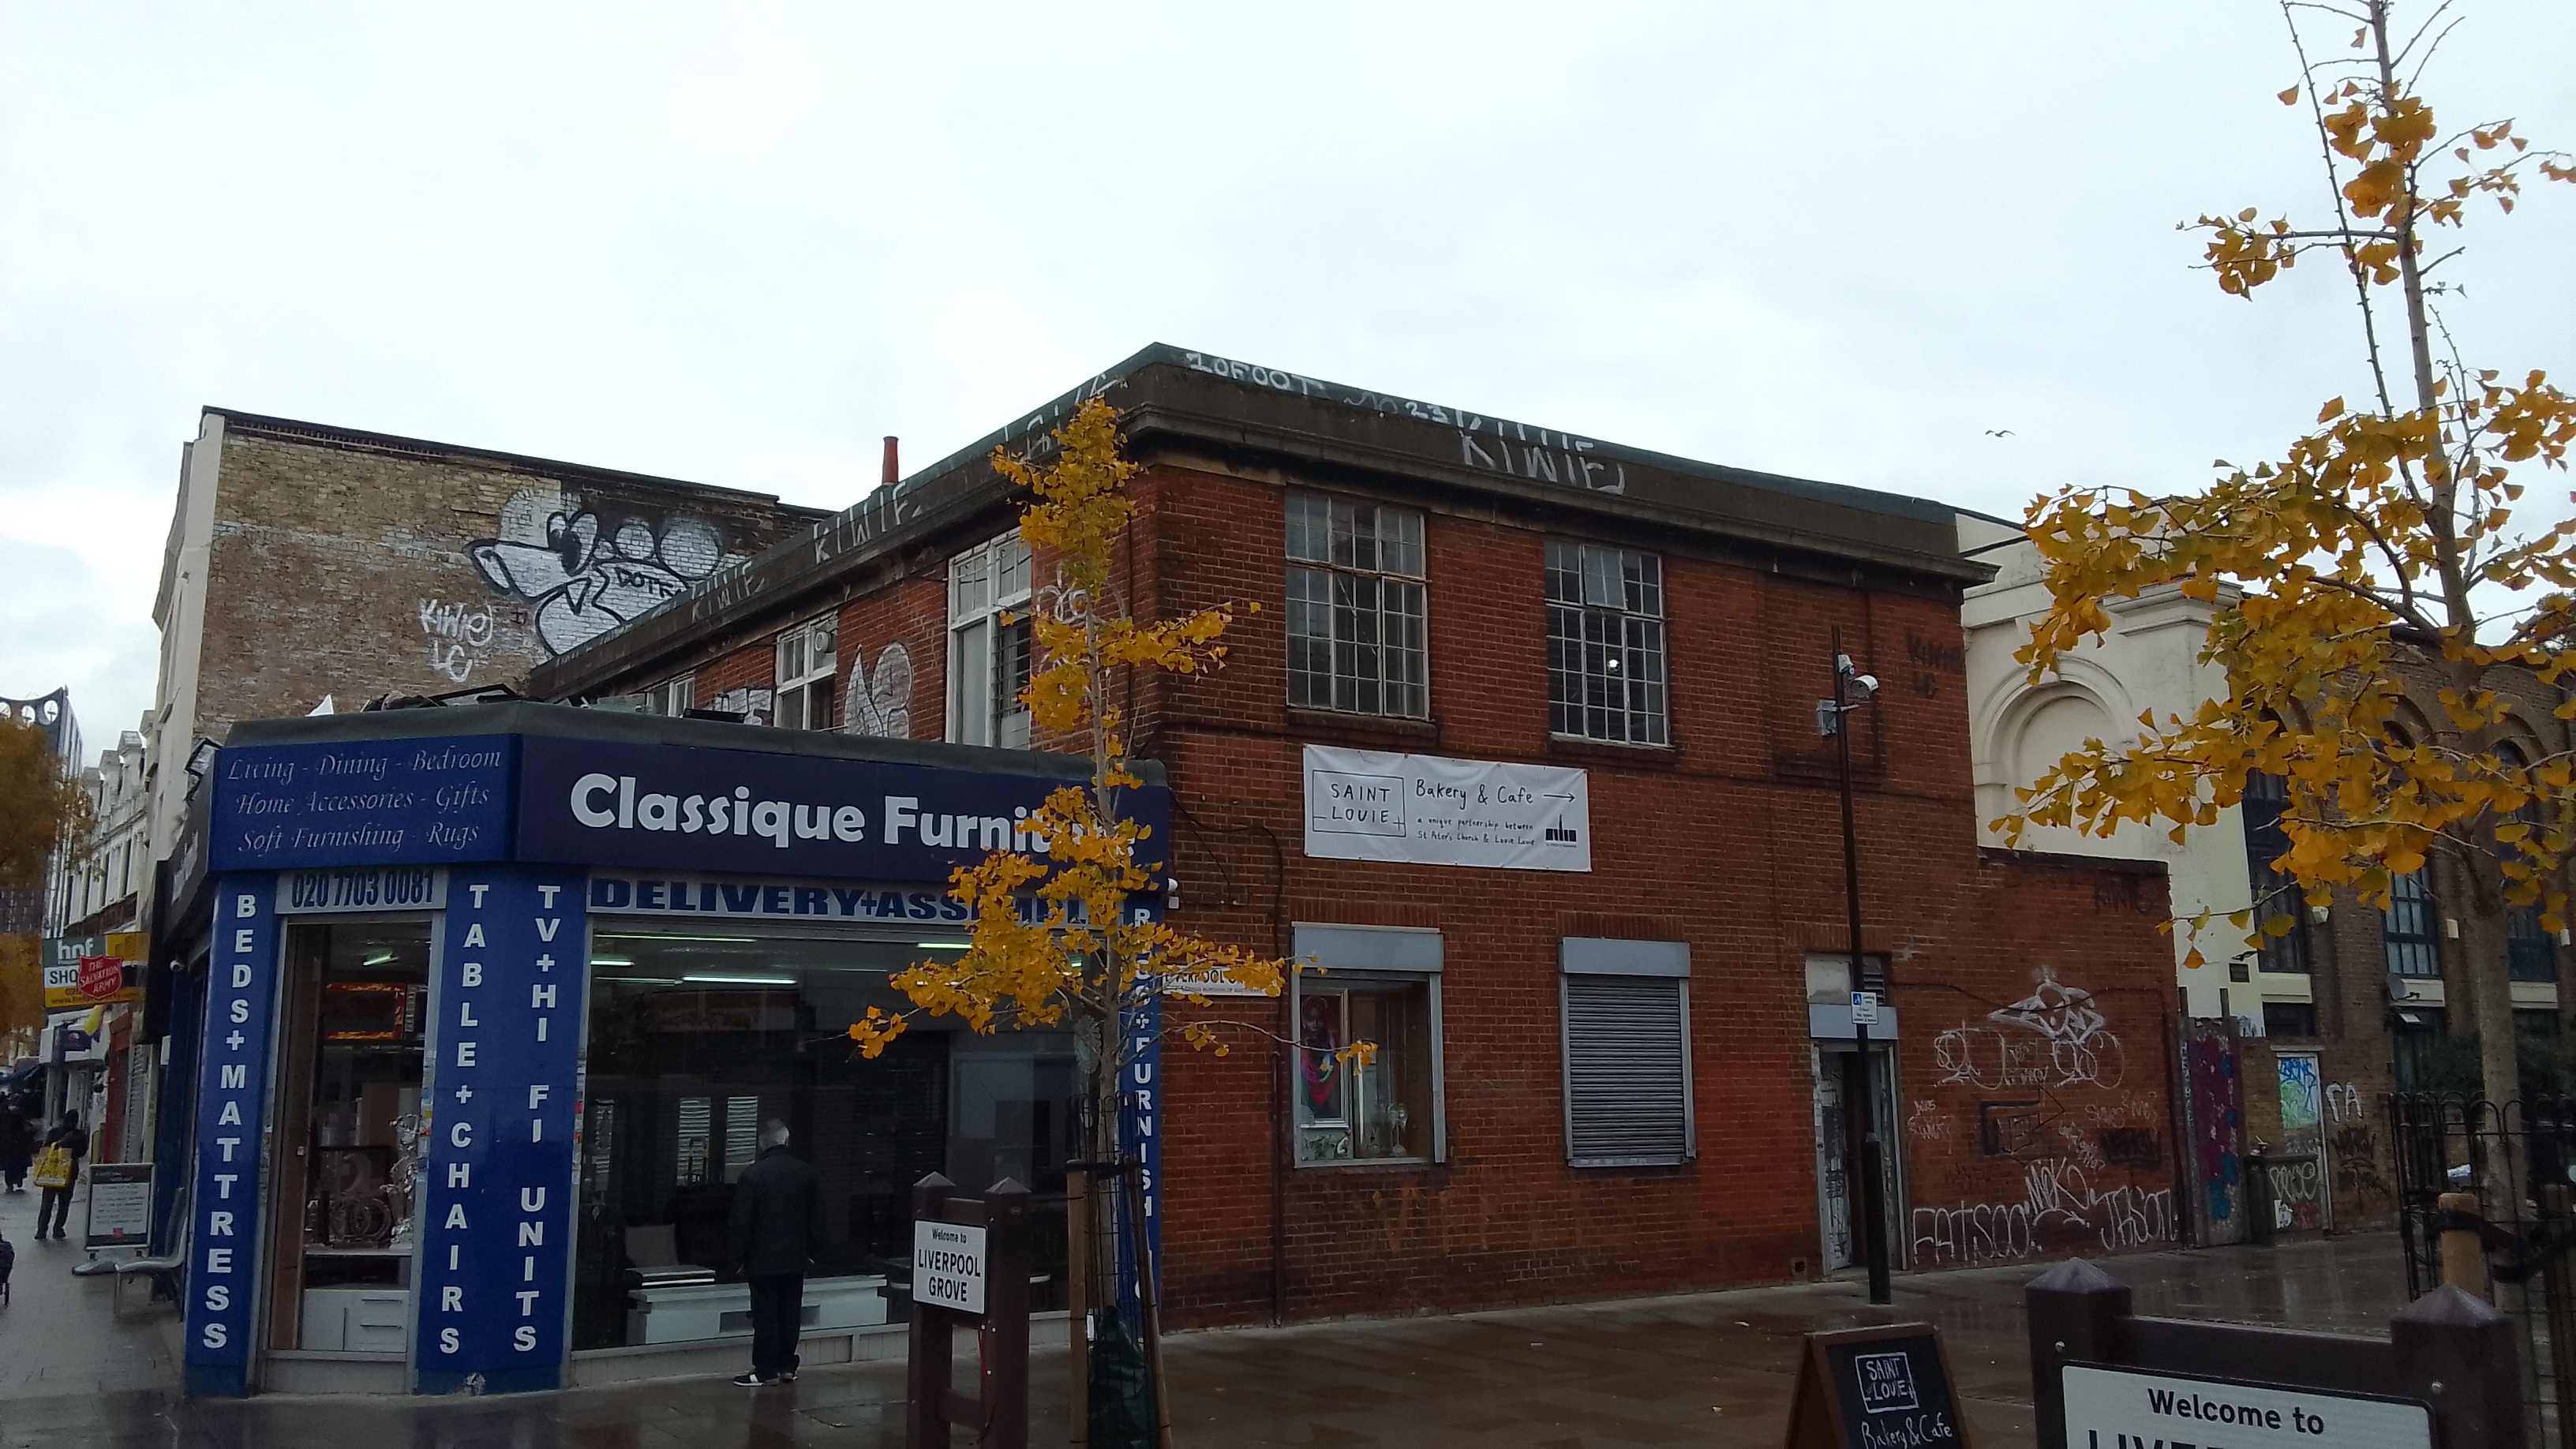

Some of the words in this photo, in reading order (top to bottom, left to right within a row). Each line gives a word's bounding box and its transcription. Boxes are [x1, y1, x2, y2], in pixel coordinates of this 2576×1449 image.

[227, 756, 295, 784] Living
[316, 753, 388, 781] Dining
[410, 745, 500, 772] Bedroom
[237, 792, 294, 816] Home
[297, 788, 414, 816] Accessories
[436, 781, 490, 814] Gifts
[1331, 783, 1391, 803] SAINT
[1416, 779, 1466, 810] Bakery
[1477, 784, 1488, 805] &
[1497, 785, 1533, 803] Cafe
[571, 773, 866, 849] Classique
[883, 795, 1136, 858] Furnit
[1331, 806, 1389, 823] LOUIE
[1428, 818, 1452, 829] unique
[1458, 818, 1500, 831] partnership
[1505, 822, 1533, 830] between
[238, 825, 283, 857] Soft
[291, 822, 404, 852] Furnishing
[426, 822, 480, 850] Rugs
[1417, 831, 1427, 840] St
[1456, 833, 1479, 842] Church
[1483, 833, 1489, 844] &
[291, 874, 330, 908] 020
[333, 871, 380, 907] 7703
[384, 869, 434, 906] 0081
[49, 968, 79, 985] SHO
[931, 1228, 959, 1243] Welcome
[960, 1232, 967, 1244] to
[918, 1249, 981, 1278] LIVERPOOL
[929, 1276, 968, 1302] GROVE
[1866, 1357, 1900, 1381] SAINT
[2147, 1387, 2282, 1430] Welcome
[2293, 1406, 2324, 1436] to
[1919, 1411, 1953, 1443] Cafe
